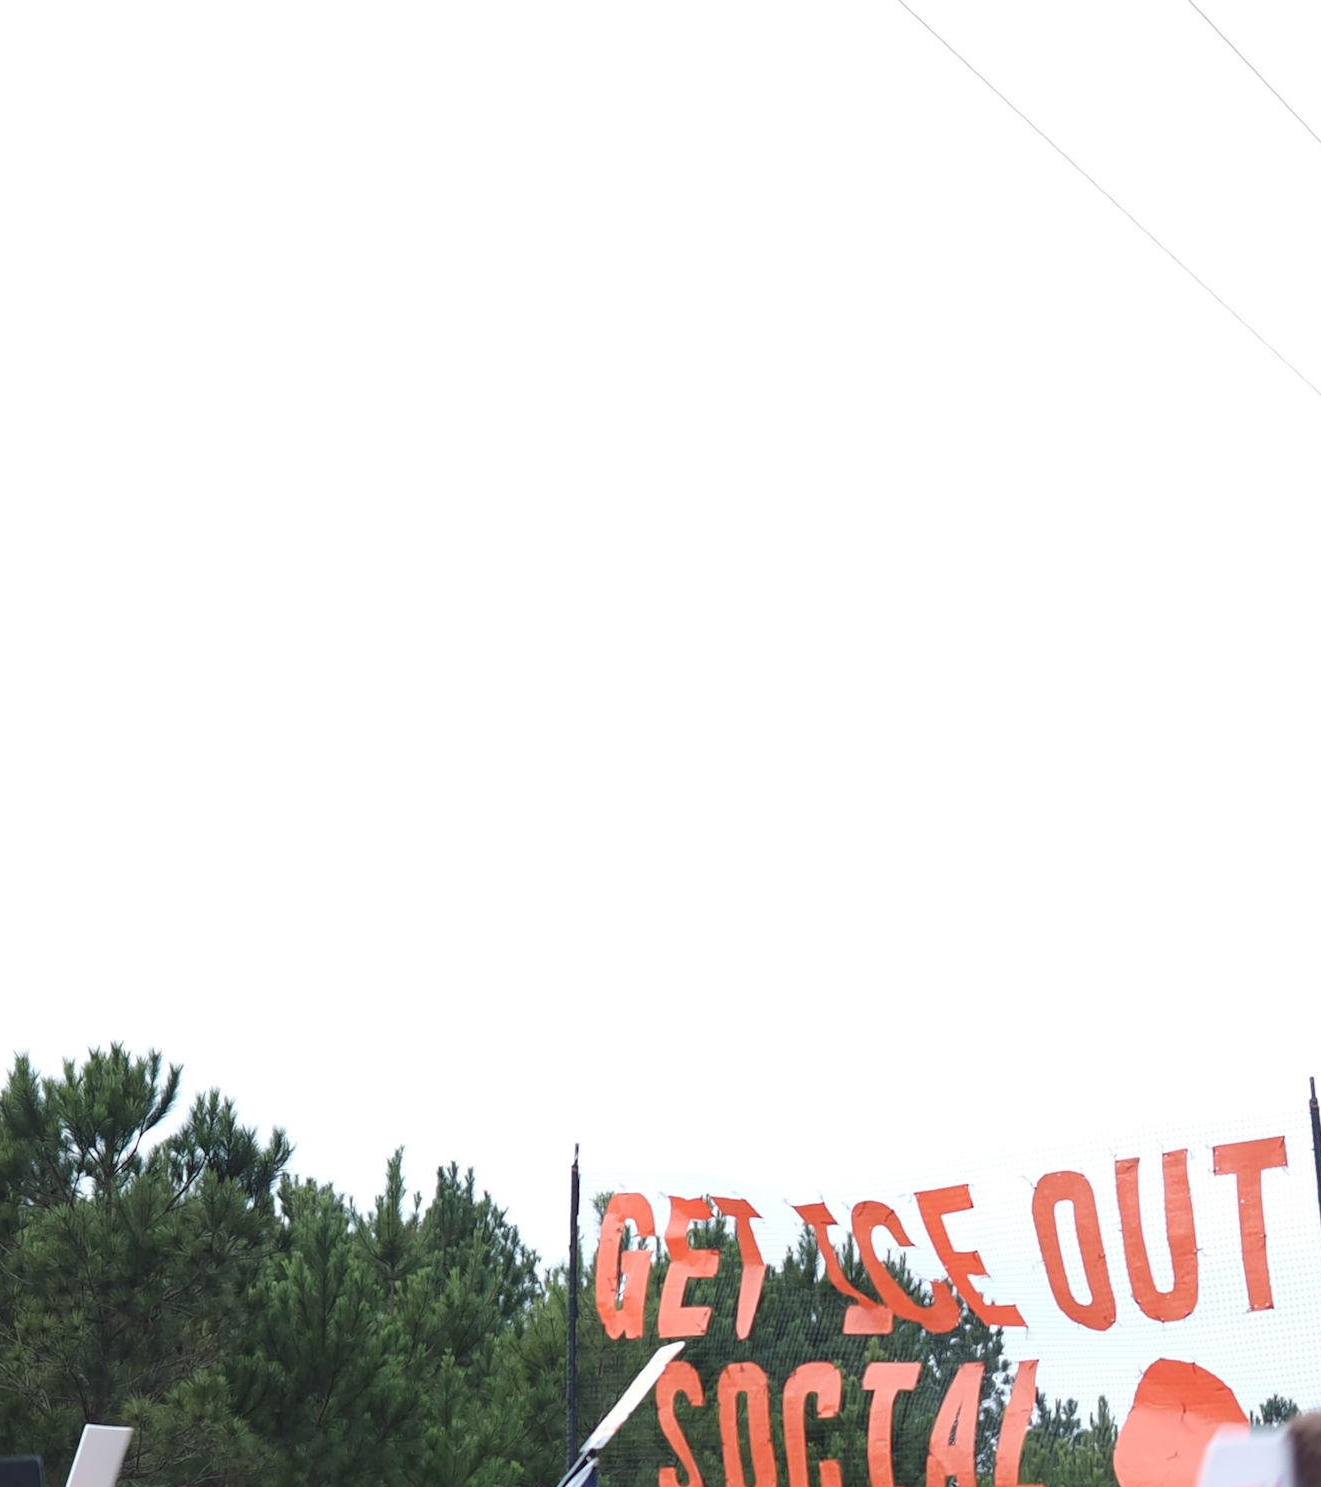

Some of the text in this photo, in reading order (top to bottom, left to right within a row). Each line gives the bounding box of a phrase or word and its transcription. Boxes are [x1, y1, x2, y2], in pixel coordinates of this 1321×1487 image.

[595, 1136, 1287, 1340] GET ICE OUT
